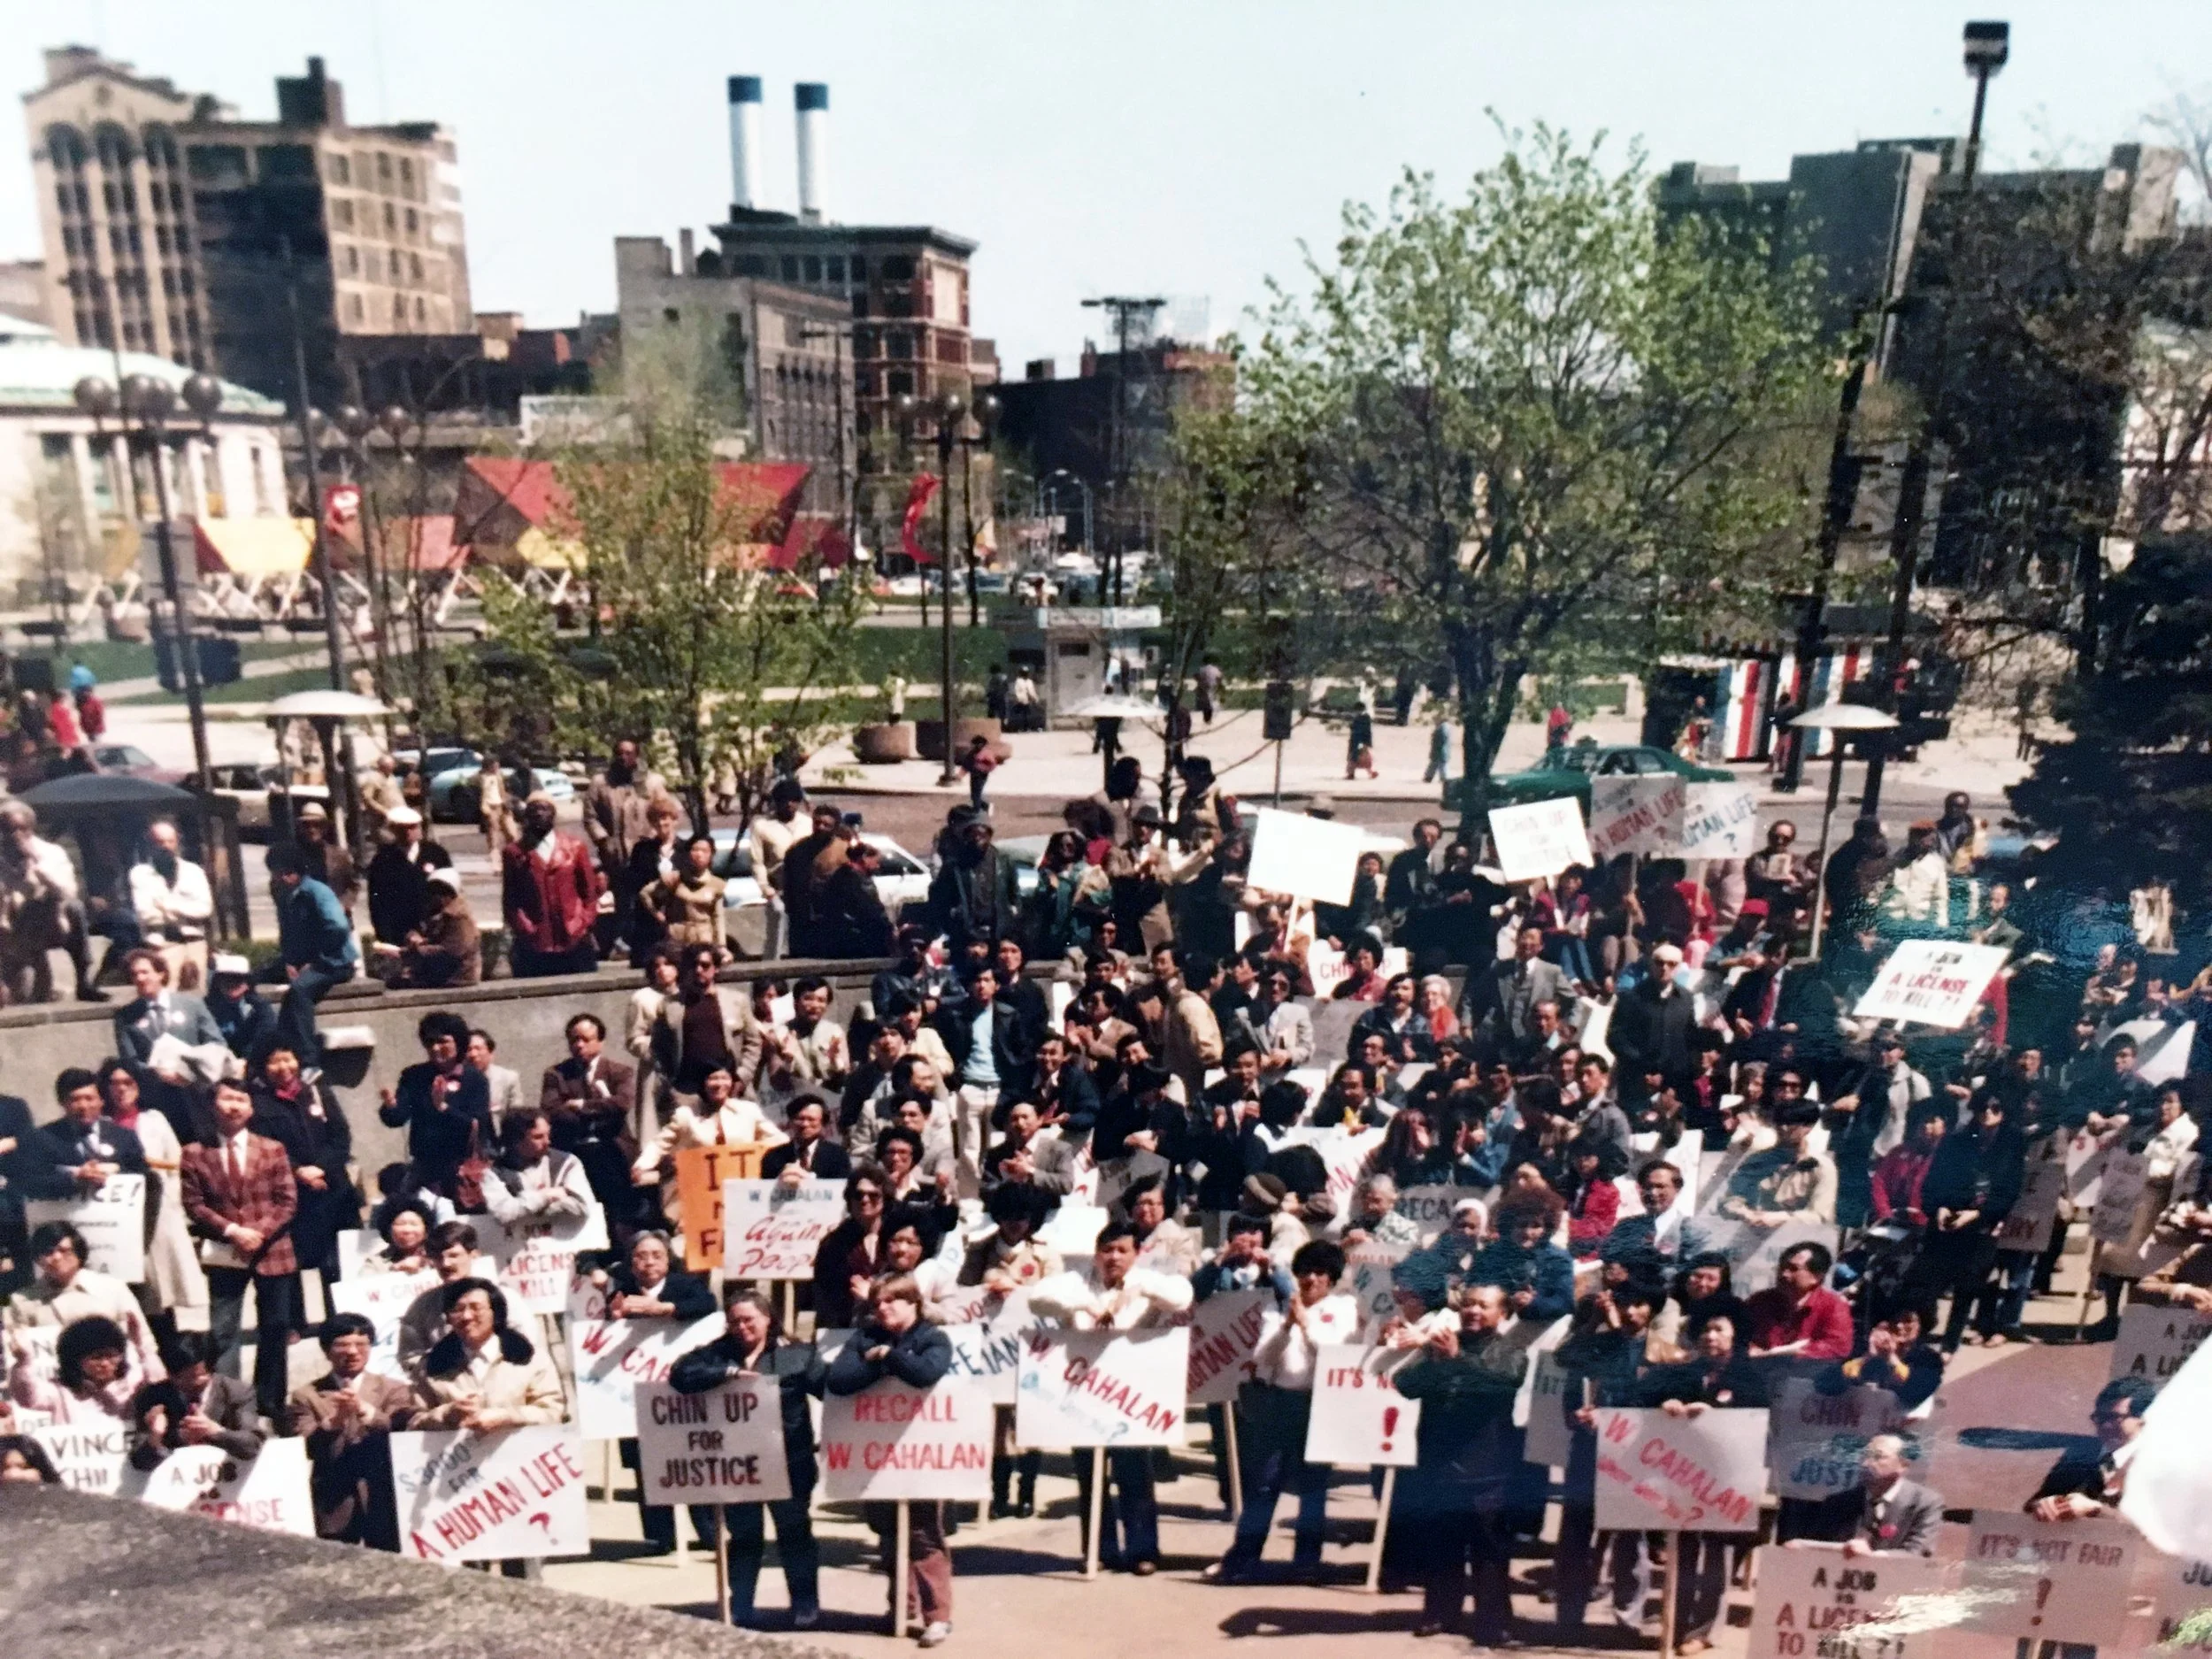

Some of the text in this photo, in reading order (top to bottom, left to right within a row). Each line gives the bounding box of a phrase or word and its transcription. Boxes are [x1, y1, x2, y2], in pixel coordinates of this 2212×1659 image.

[1724, 792, 1758, 825] LIFE
[1888, 972, 1972, 995] A LICENSE
[581, 1324, 612, 1355] W
[1327, 1367, 1364, 1389] IT'S
[2130, 1353, 2147, 1374] A
[651, 1391, 758, 1425] CHIN UP
[853, 1392, 958, 1423] RECALL
[1063, 1355, 1179, 1434] CAHALAN
[687, 1430, 725, 1452] FOR
[1380, 1405, 1400, 1453] !
[826, 1440, 986, 1471] W CAHALAN
[1604, 1411, 1631, 1443] W
[1639, 1437, 1755, 1524] CAHALAN
[1790, 1456, 1862, 1486] JUST
[171, 1462, 239, 1486] A JOB
[658, 1455, 763, 1490] JUSTICE
[410, 1442, 583, 1559] A HUMAN LIFE
[528, 1511, 559, 1546] ?
[2077, 1542, 2124, 1567] FAIR
[1811, 1567, 1878, 1591] A JOB
[1775, 1601, 1795, 1628] A
[2031, 1577, 2053, 1626] !
[1777, 1631, 1805, 1656] TO
